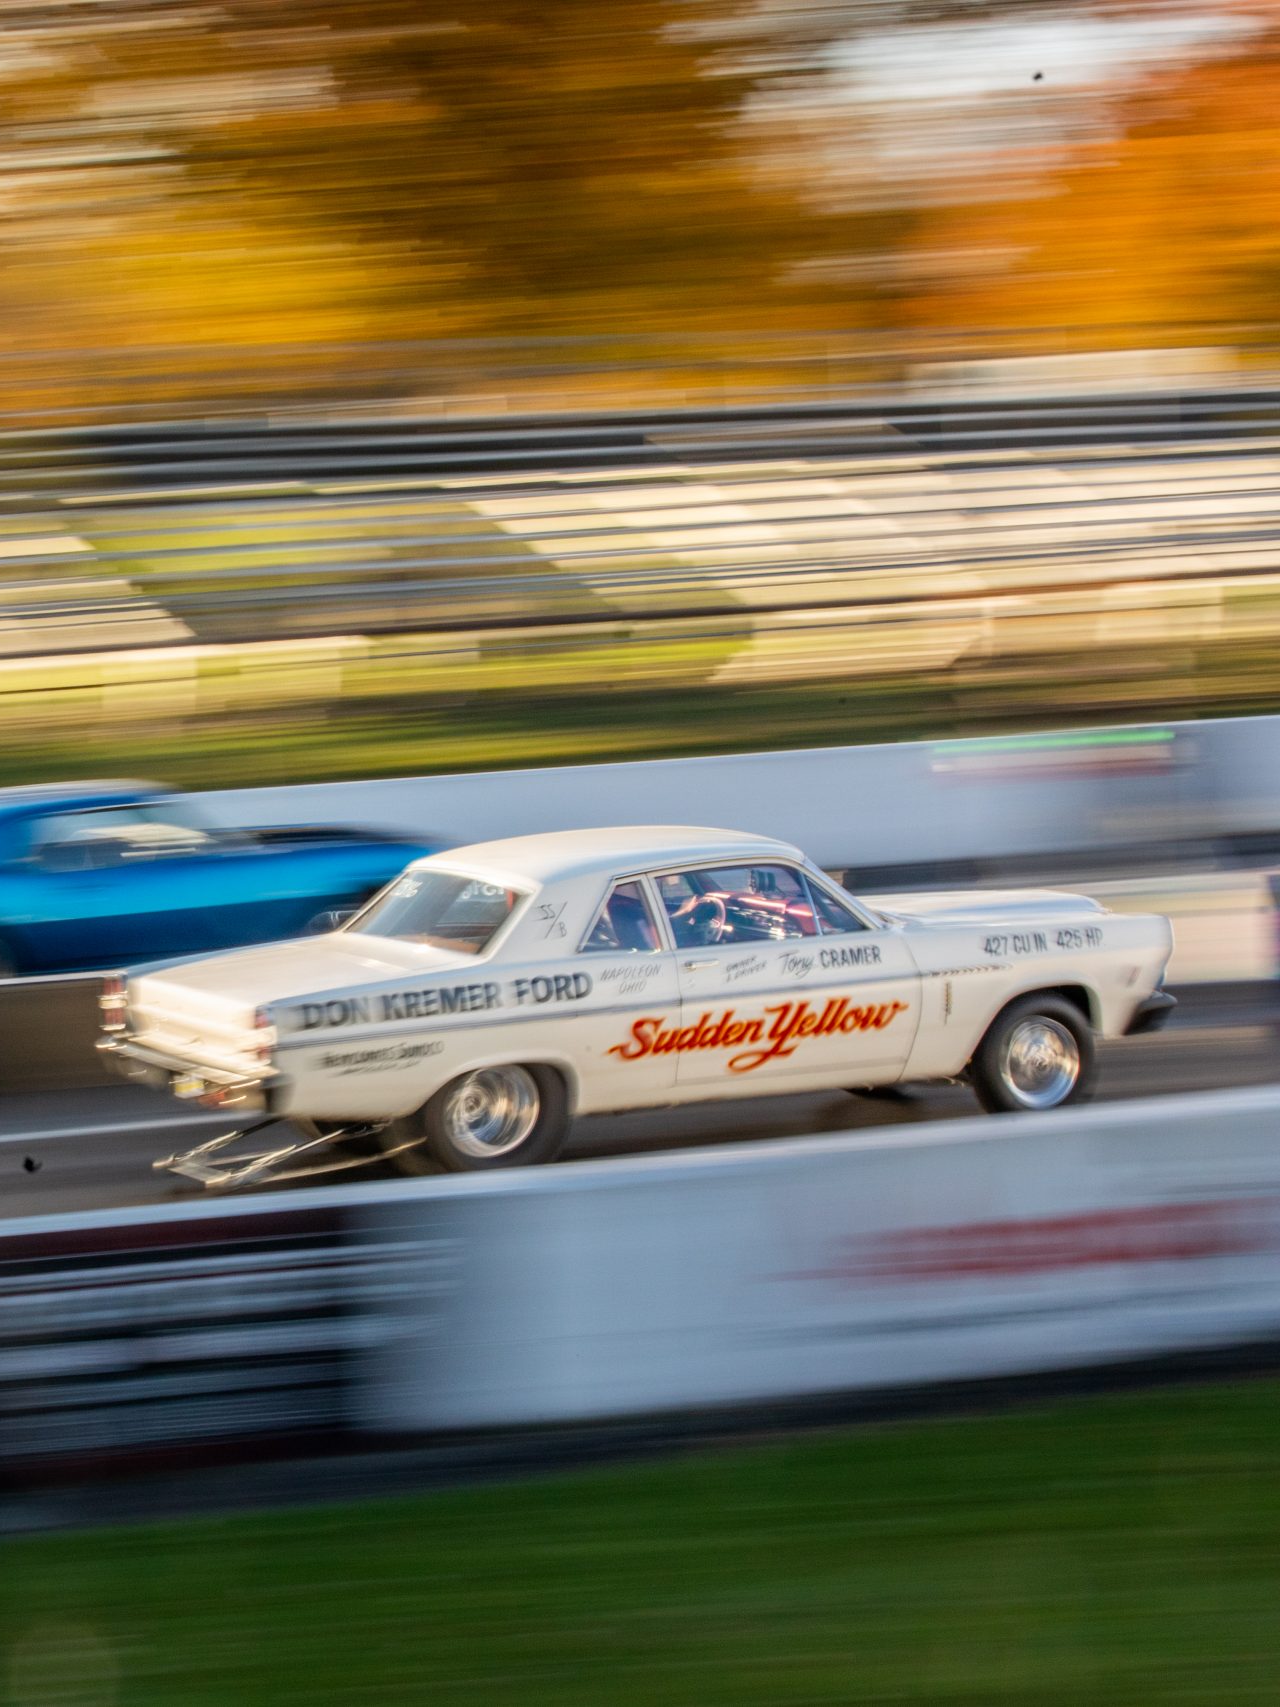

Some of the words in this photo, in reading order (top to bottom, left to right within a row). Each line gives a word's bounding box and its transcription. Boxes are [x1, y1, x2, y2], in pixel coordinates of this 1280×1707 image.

[984, 935, 1008, 957] 427
[1056, 929, 1082, 949] 425
[778, 950, 813, 979] Tony
[820, 945, 882, 968] CRAMER
[301, 996, 375, 1030] DON
[381, 982, 502, 1021] KREMER
[513, 971, 594, 1005] FORD
[620, 980, 648, 994] OHIO
[607, 1009, 766, 1060] Sudden
[728, 997, 909, 1073] Yellow
